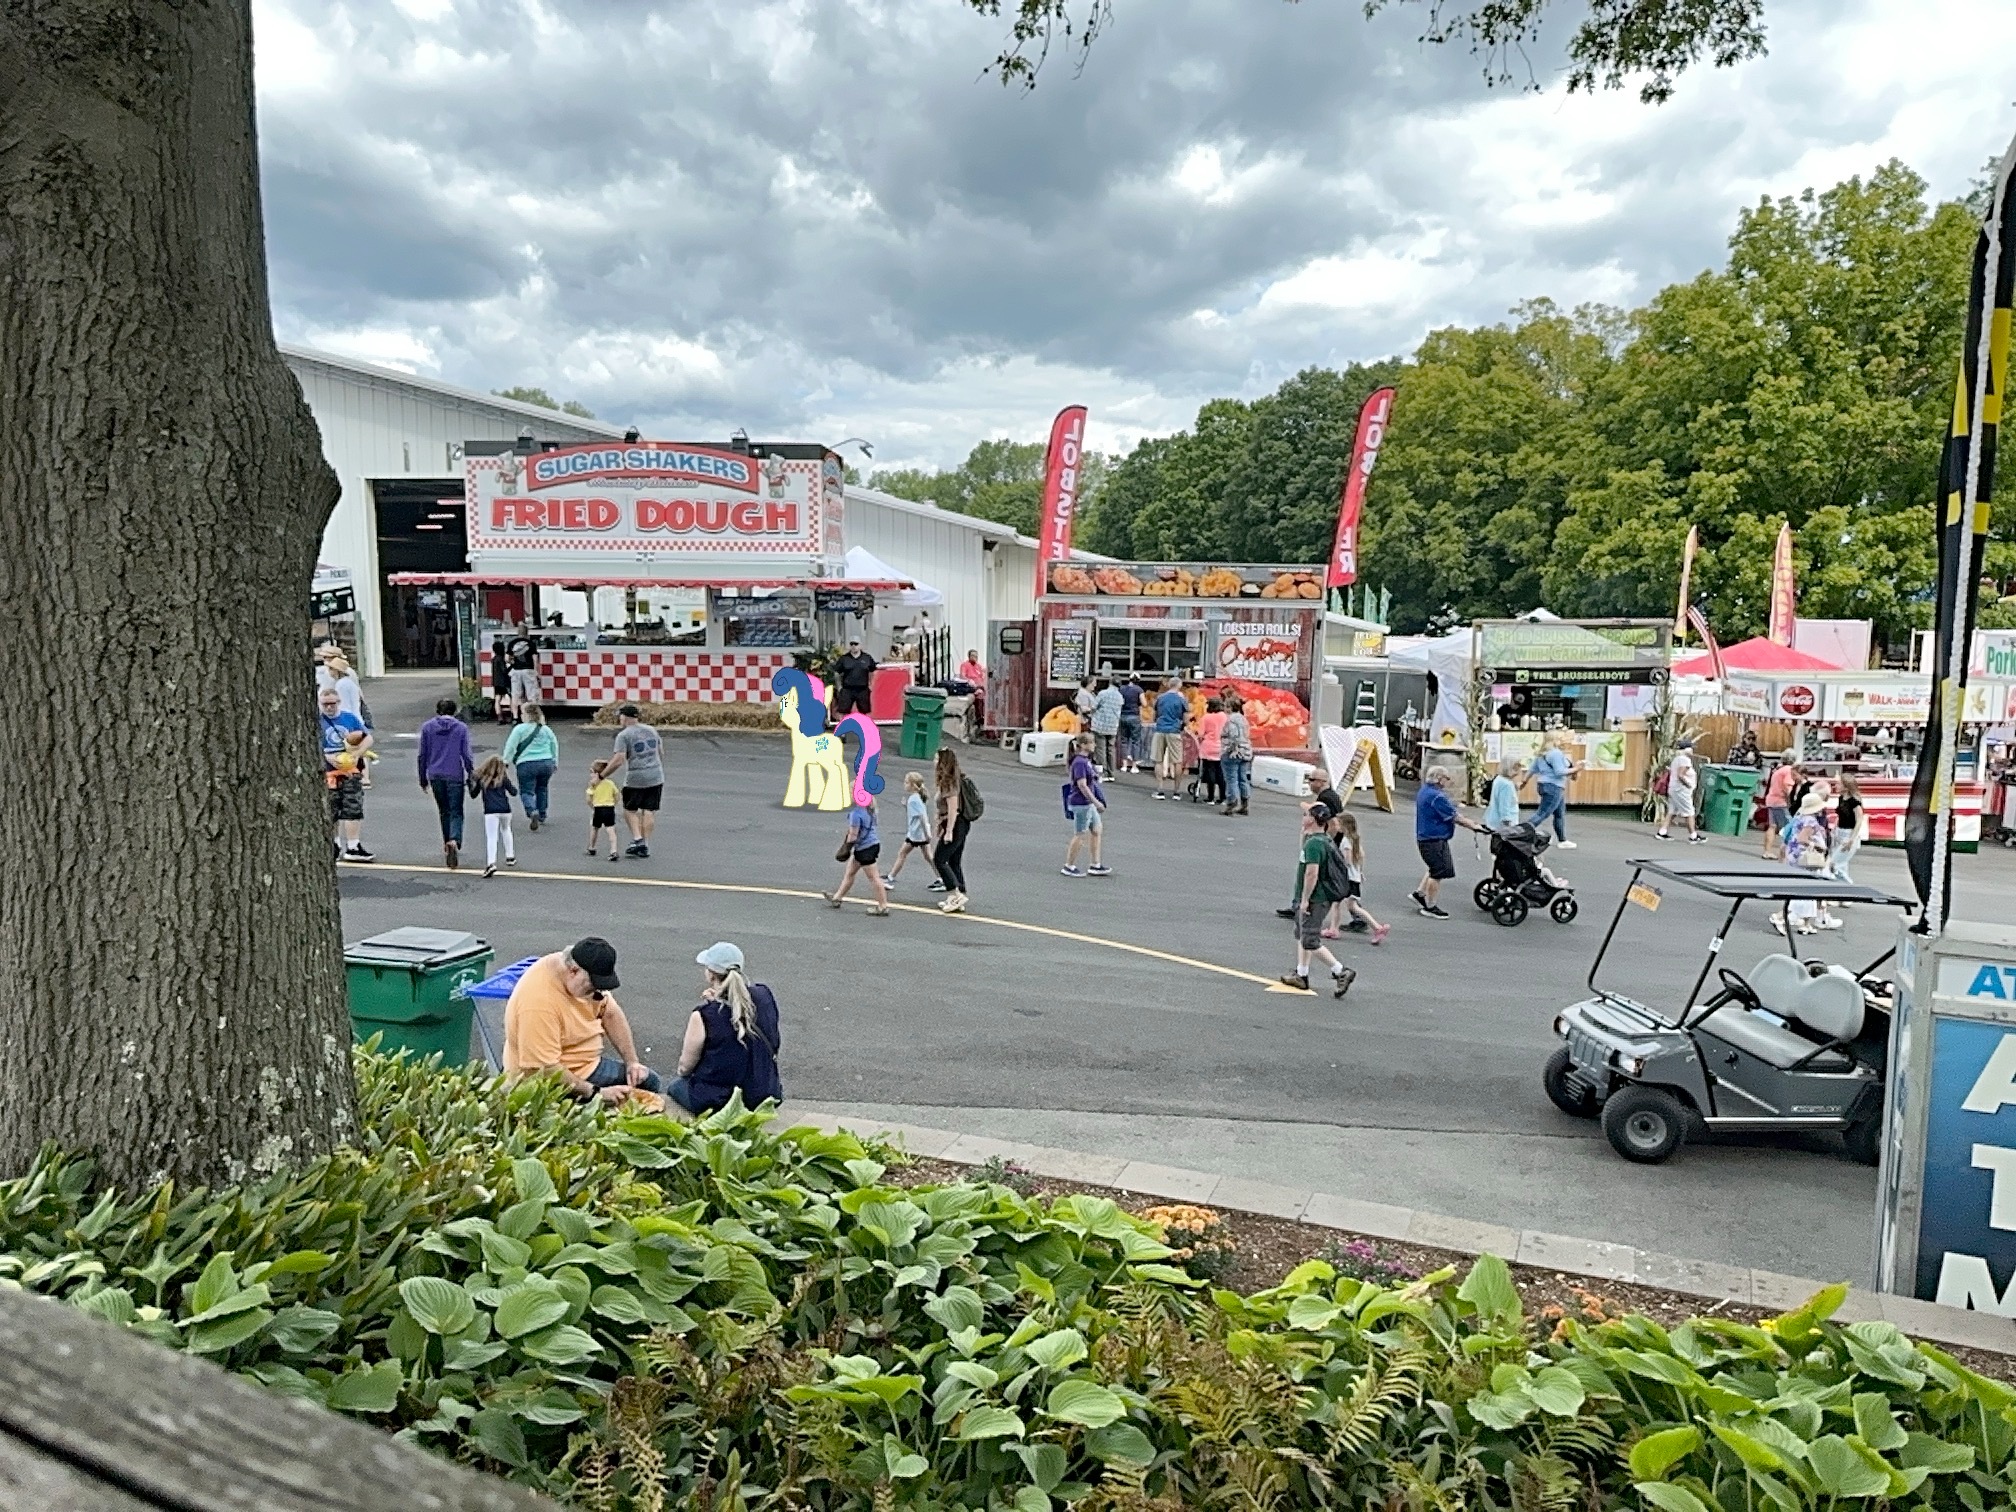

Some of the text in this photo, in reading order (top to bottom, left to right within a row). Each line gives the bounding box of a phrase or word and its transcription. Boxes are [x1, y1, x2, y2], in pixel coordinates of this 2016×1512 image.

[536, 449, 750, 483] SUGAR SHAKERS
[490, 496, 621, 532] FRIED
[635, 497, 801, 533] DOUGH
[1219, 622, 1302, 637] LOBSTER ROLLS!
[1532, 628, 1595, 645] BRUSSELS
[1551, 645, 1599, 661] GARLIC
[1233, 659, 1294, 678] SHACK
